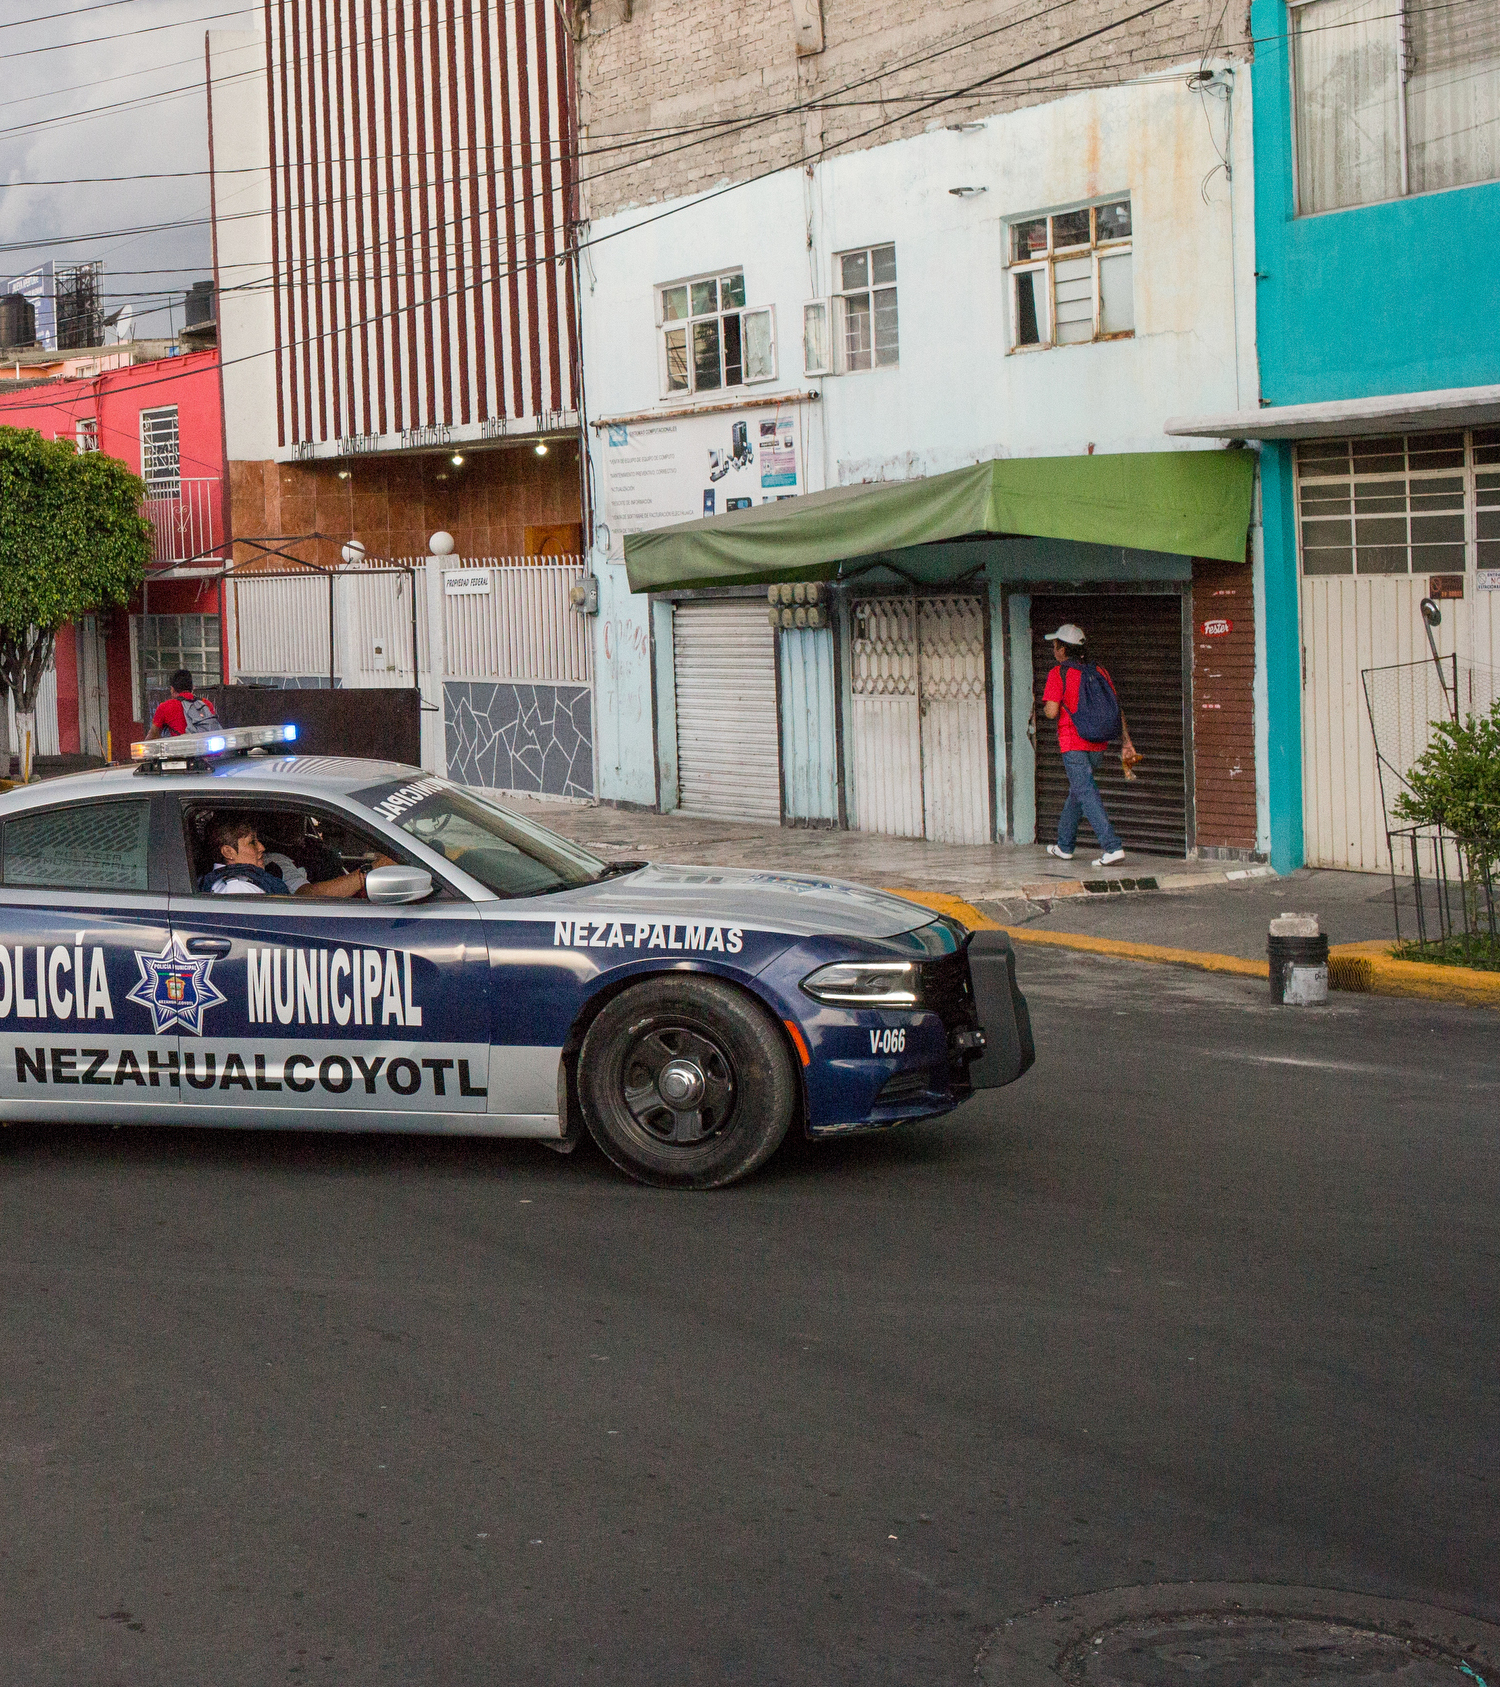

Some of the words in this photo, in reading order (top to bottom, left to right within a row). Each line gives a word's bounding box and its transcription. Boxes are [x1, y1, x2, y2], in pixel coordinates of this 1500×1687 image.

[446, 578, 470, 588] PROPIEDAD
[470, 577, 489, 587] FEDERAL
[1204, 620, 1229, 635] Fester
[553, 920, 743, 953] NEZA-PALMAS
[247, 948, 423, 1027] MUNICIPAL
[869, 1028, 906, 1055] V-066
[15, 1047, 489, 1098] NEZAHUALCOYOTL
